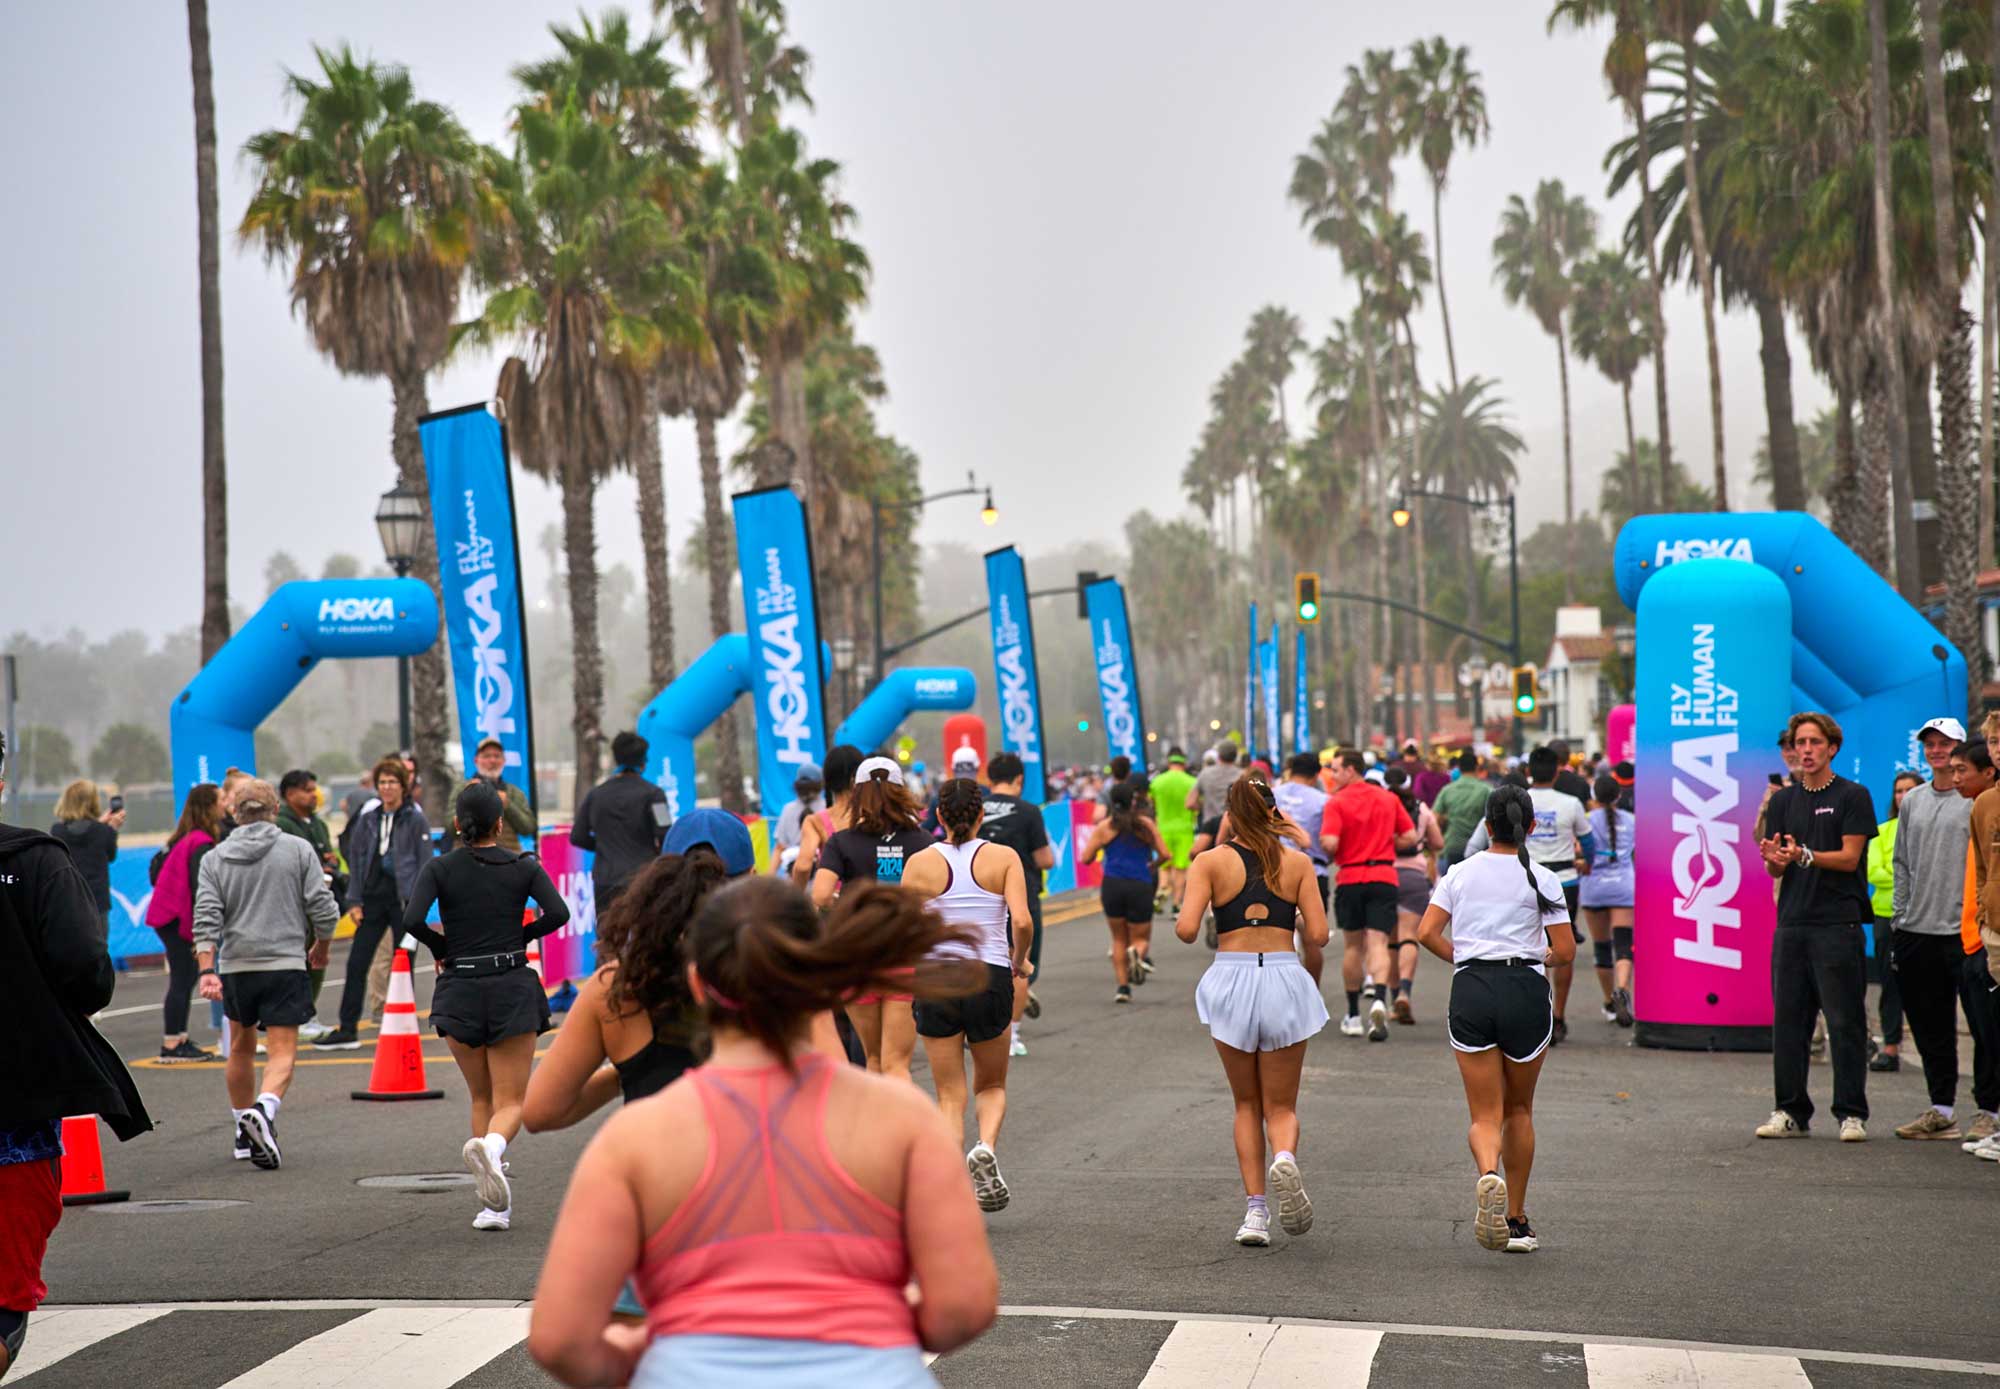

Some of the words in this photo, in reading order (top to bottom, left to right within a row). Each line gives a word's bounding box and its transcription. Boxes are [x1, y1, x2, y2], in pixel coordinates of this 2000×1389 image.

[455, 541, 473, 575] FLY
[478, 536, 496, 571] FLY
[1655, 538, 1754, 568] HOKA
[318, 597, 395, 621] HOKA
[463, 573, 522, 767] HOKA
[759, 612, 814, 767] HOKA
[1692, 623, 1715, 726] HUMAN
[997, 643, 1040, 763] HOKA
[1100, 661, 1138, 765] HOKA
[1670, 682, 1692, 726] FLY
[1716, 682, 1739, 726] FLY
[877, 858, 903, 876] 2024
[1671, 732, 1742, 970] HOKA
